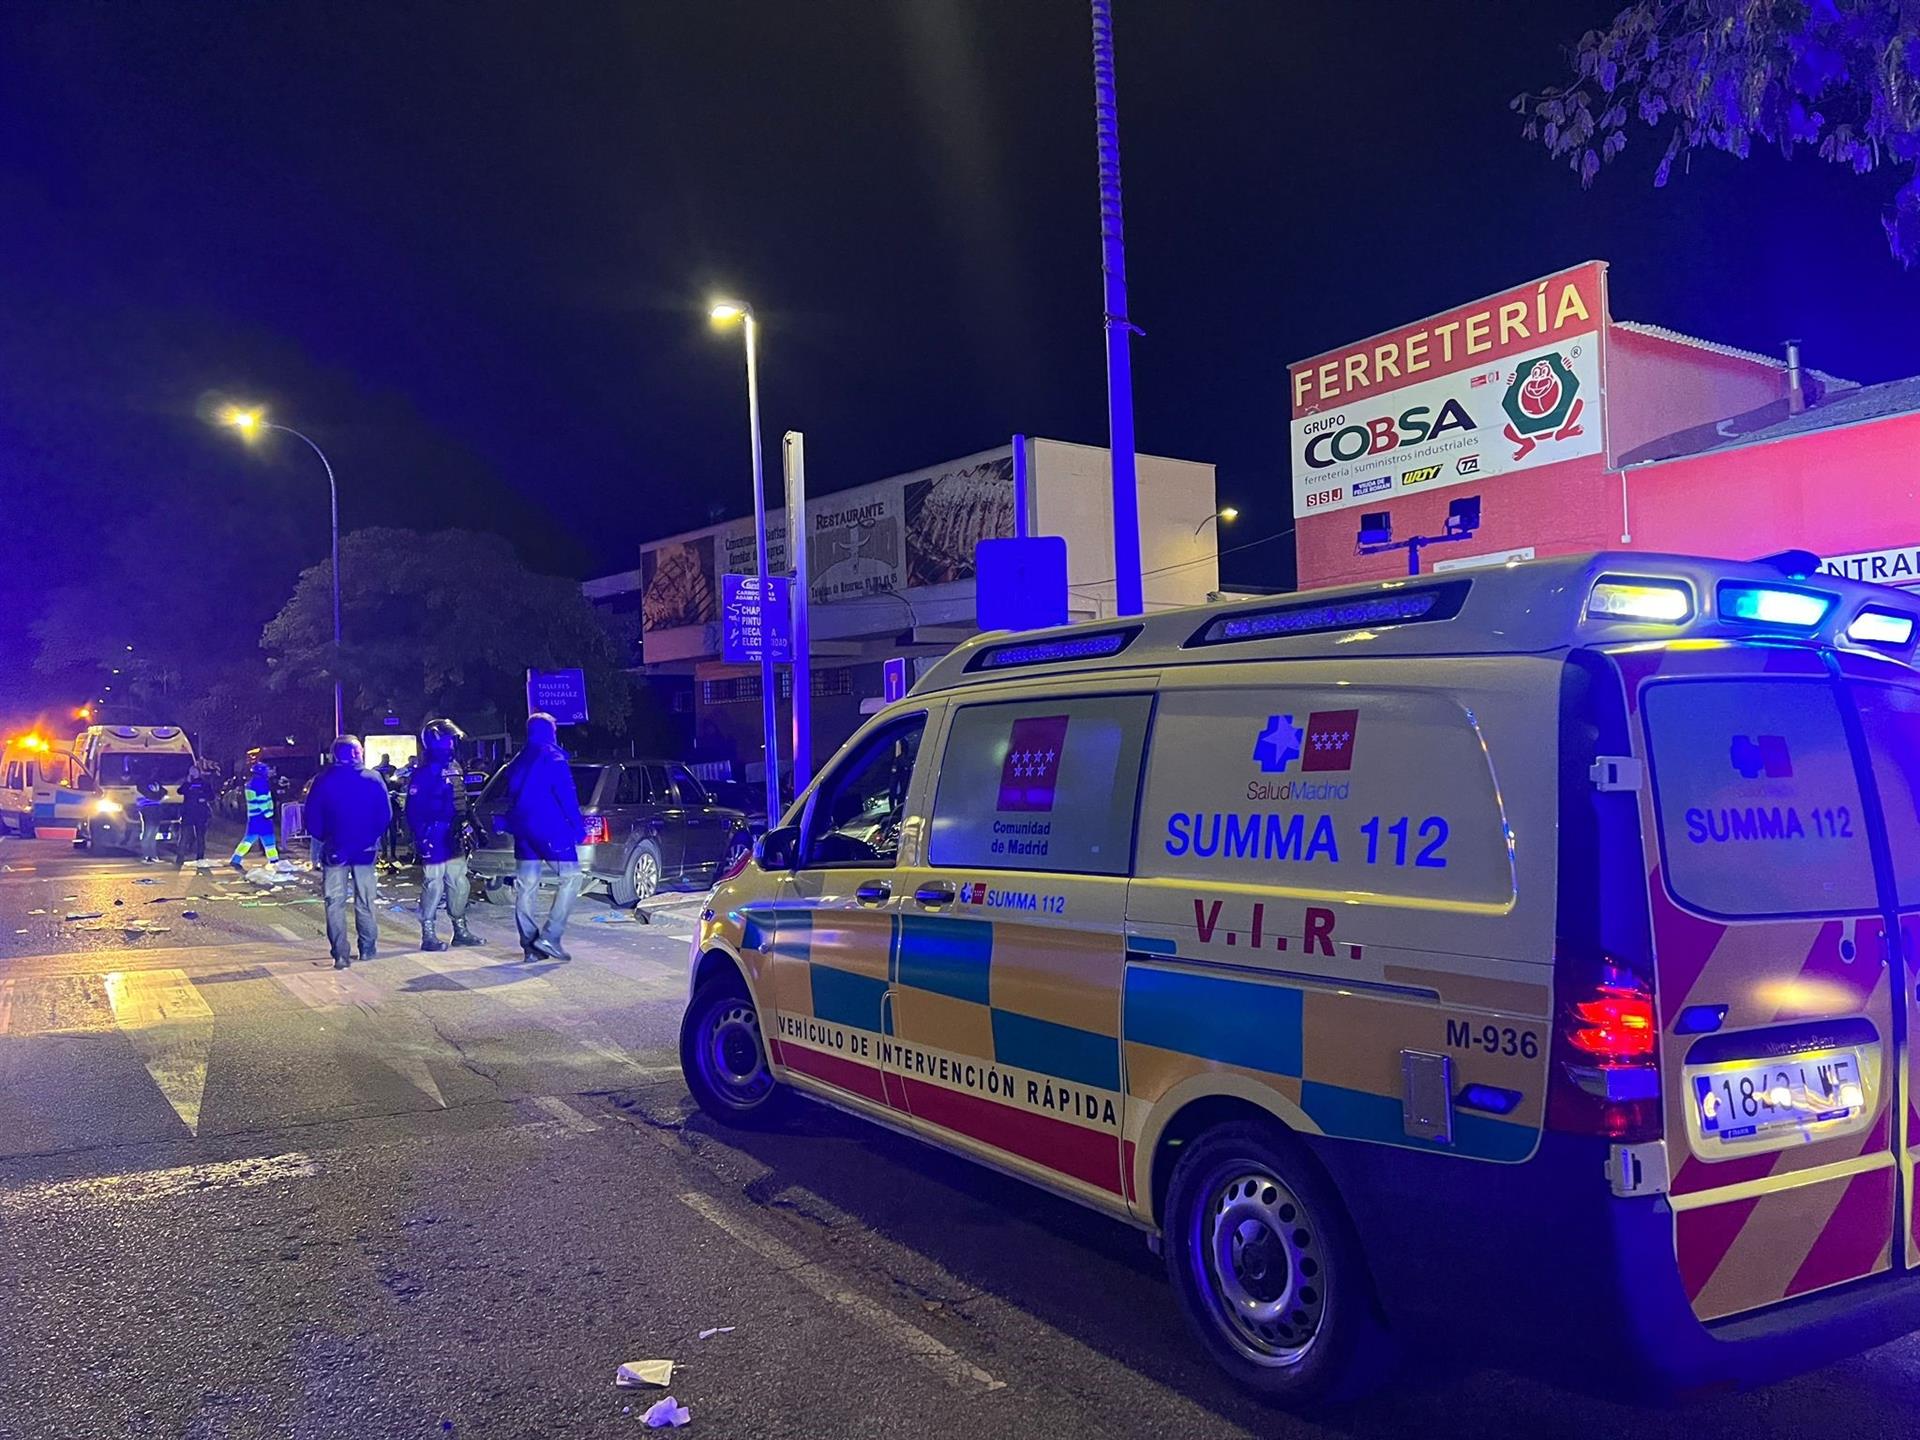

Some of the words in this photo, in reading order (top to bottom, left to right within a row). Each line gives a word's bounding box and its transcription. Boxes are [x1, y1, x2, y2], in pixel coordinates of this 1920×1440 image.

[1295, 281, 1589, 406] FERRETERÍA
[1304, 414, 1345, 435] GRUPO
[1304, 398, 1478, 469] COBSA
[1304, 469, 1350, 485] ferretería
[1354, 453, 1412, 474] suministros
[1414, 437, 1479, 458] industriales
[1247, 781, 1349, 801] SaludMadrid
[993, 820, 1051, 836] Comunidad
[1165, 813, 1339, 863] SUMMA
[1361, 816, 1449, 868] 112
[1685, 807, 1805, 844] SUMMA
[1811, 805, 1853, 839] 112
[991, 840, 1005, 854] de
[1008, 840, 1049, 856] Madrid
[987, 889, 1037, 911] SUMMA
[1042, 895, 1065, 914] 112
[1446, 1019, 1539, 1060] M-936
[778, 1015, 844, 1050] VEHÍCULO
[851, 1036, 869, 1058] DE
[876, 1041, 1015, 1099] INTERVENCIÓN
[1027, 1078, 1117, 1126] RÁPIDA
